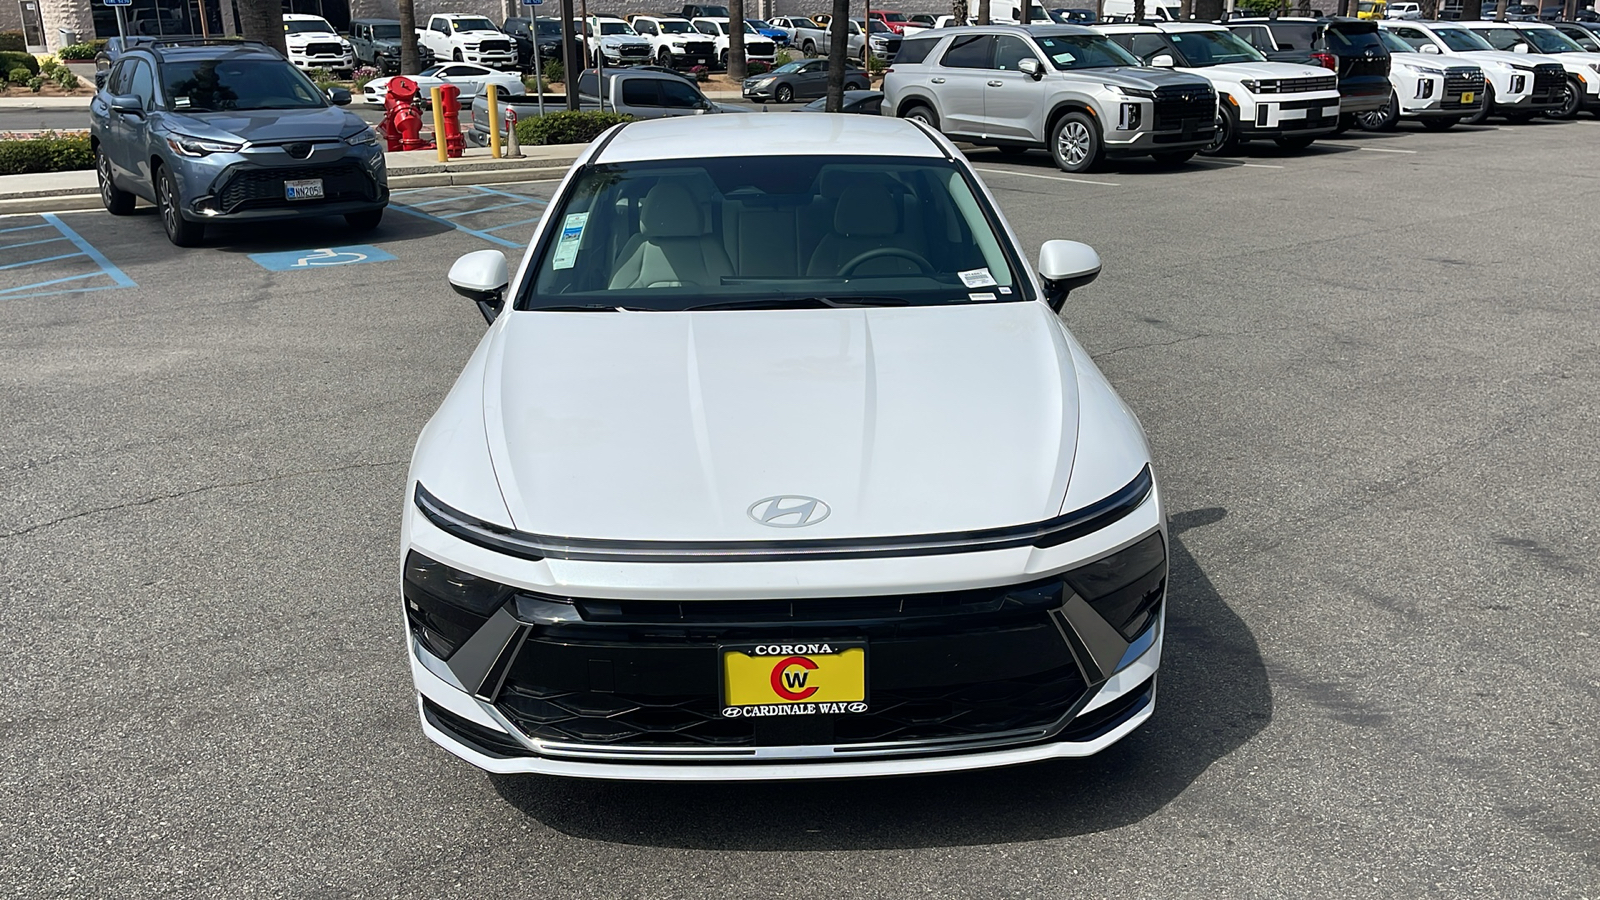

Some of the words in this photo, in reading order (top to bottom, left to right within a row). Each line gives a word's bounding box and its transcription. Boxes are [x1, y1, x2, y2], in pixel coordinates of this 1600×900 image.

[755, 643, 832, 655] CORONA
[743, 703, 816, 717] CARDINALE
[819, 702, 848, 714] WAY
